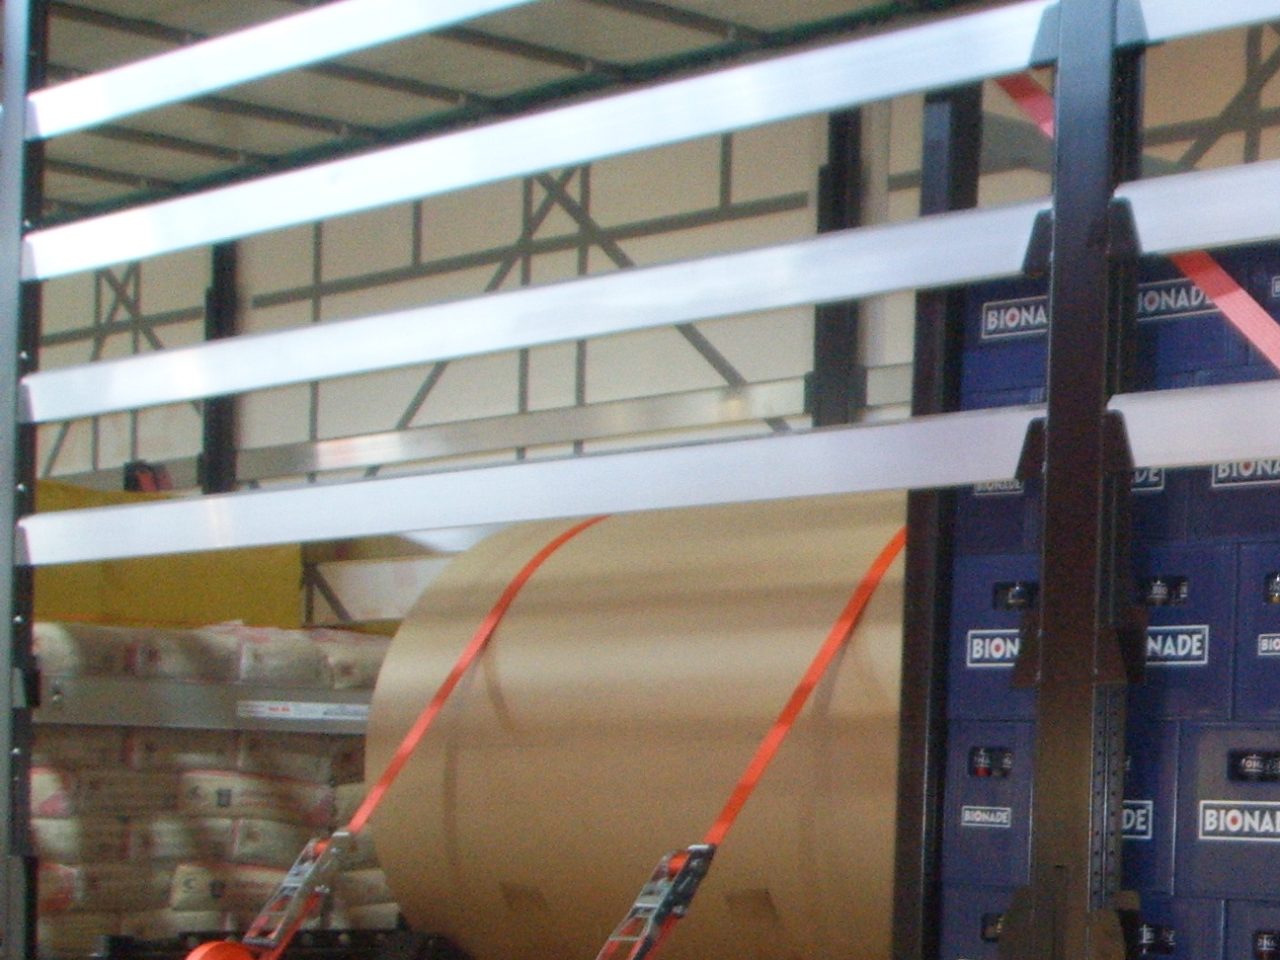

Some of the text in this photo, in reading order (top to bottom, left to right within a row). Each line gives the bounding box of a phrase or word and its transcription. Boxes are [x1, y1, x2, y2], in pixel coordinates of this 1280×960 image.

[986, 304, 1048, 331] BIONA
[972, 637, 1020, 659] BION
[1147, 634, 1203, 656] NADE
[963, 809, 1009, 824] BIONADE
